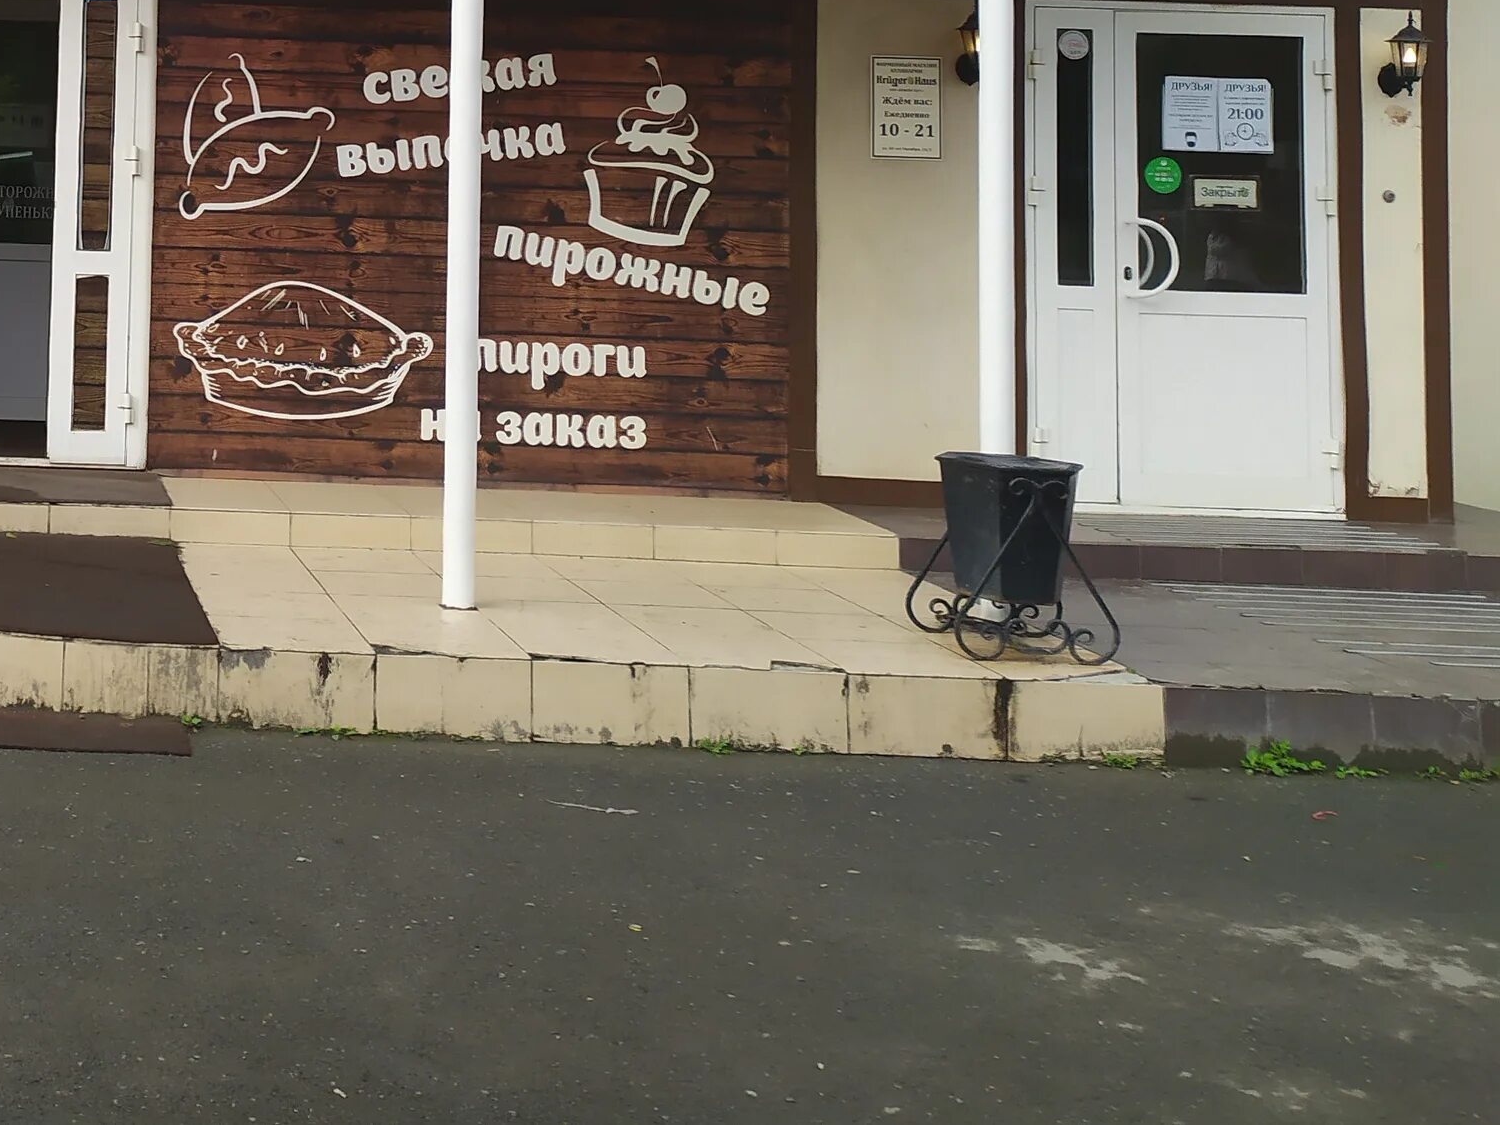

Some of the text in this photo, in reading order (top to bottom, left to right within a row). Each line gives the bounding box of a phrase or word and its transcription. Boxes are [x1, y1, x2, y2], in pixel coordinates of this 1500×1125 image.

[1171, 81, 1213, 91] ДРУЗЬЯ!
[1224, 83, 1267, 92] ДРУЗЬЯ!
[882, 96, 911, 105] Ждём
[884, 110, 930, 118] Ежедневно
[1227, 107, 1264, 120] 21:00
[879, 123, 899, 136] 10
[915, 124, 934, 137] 21
[336, 122, 566, 178] выпчка
[493, 225, 770, 317] пирожные
[478, 338, 648, 390] пироги
[420, 408, 648, 450] н заказ
